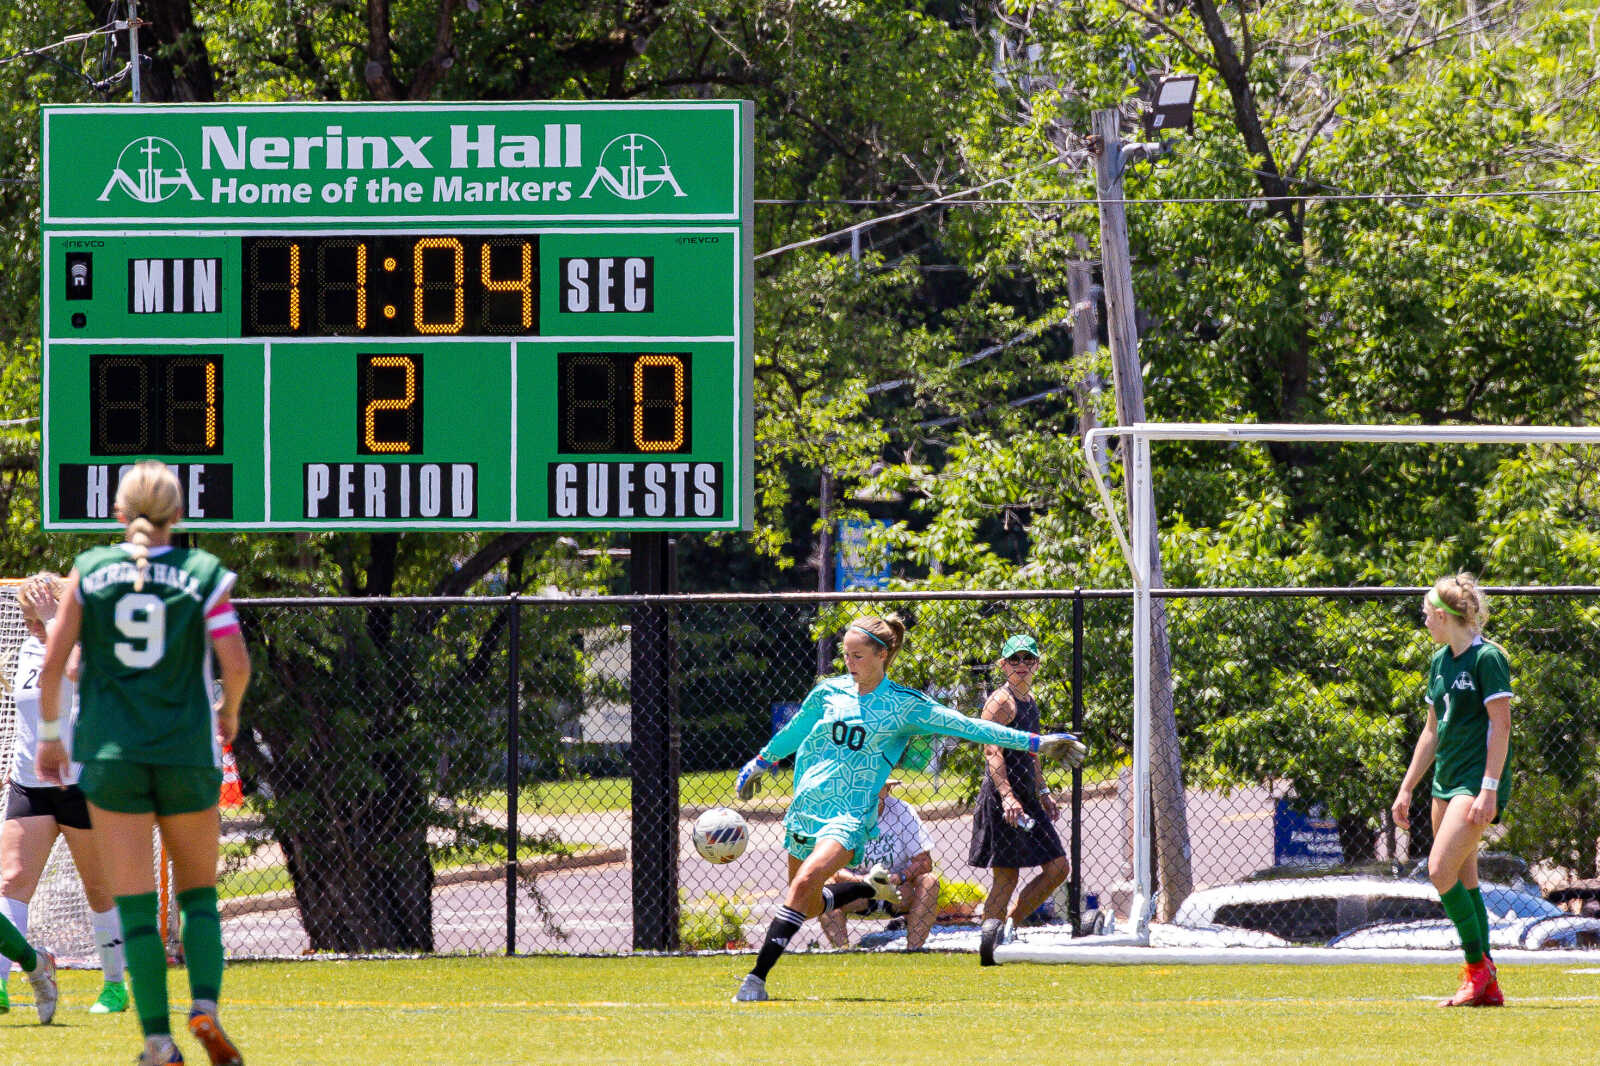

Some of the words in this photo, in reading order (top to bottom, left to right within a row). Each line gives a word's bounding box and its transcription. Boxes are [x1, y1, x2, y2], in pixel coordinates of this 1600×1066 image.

[201, 125, 433, 170] Nerinx
[450, 124, 582, 168] Hall
[211, 178, 312, 204] Home
[321, 177, 357, 203] of
[363, 177, 423, 203] the
[432, 176, 572, 202] Markers
[133, 259, 217, 313] MIN
[289, 237, 532, 334] 11:04
[567, 257, 647, 313] SEC
[205, 362, 216, 448] 1
[365, 356, 416, 452] 2
[633, 355, 684, 451] 0
[87, 464, 205, 518] HE
[307, 463, 474, 518] PERIOD
[555, 463, 716, 518] GUESTS
[114, 593, 166, 669] 9
[832, 720, 867, 751] 00
